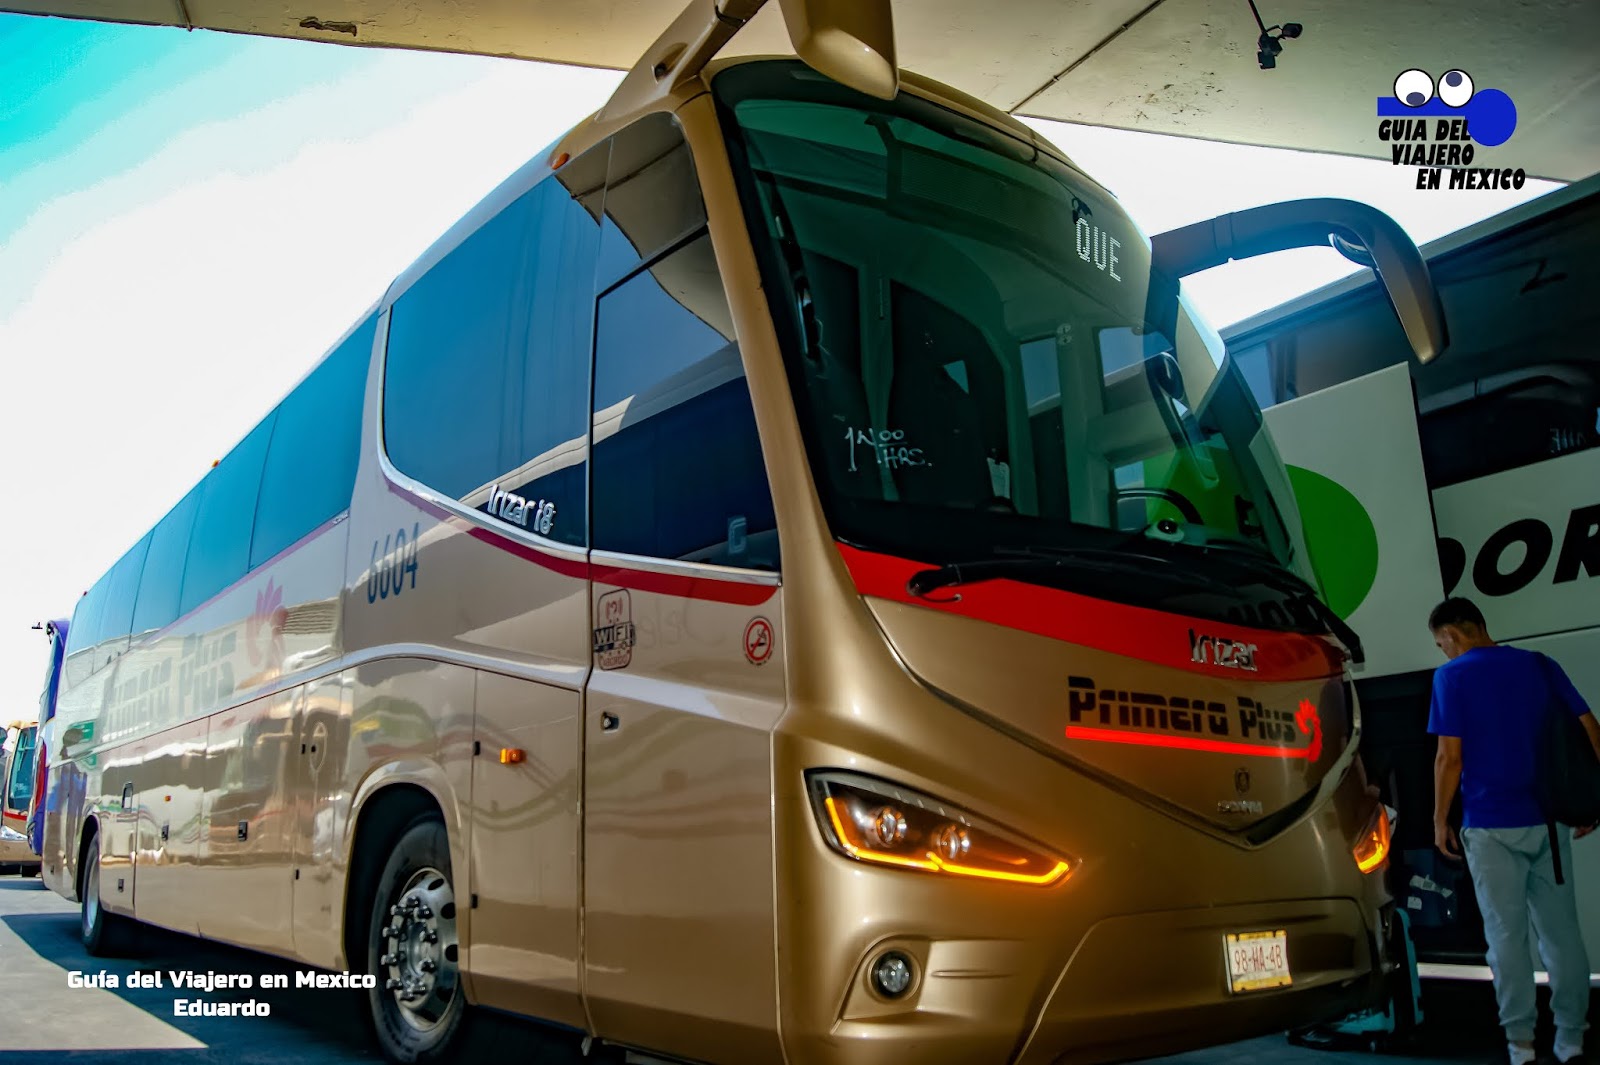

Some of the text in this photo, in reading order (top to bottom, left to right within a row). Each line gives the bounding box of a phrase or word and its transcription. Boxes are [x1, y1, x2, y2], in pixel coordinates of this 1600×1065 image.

[1076, 217, 1121, 282] QUE
[487, 483, 557, 535] Irizar i8
[367, 521, 419, 604] 6604
[178, 630, 238, 719] Plus
[1188, 628, 1258, 672] Irizar
[1068, 675, 1296, 743] Primera Plus
